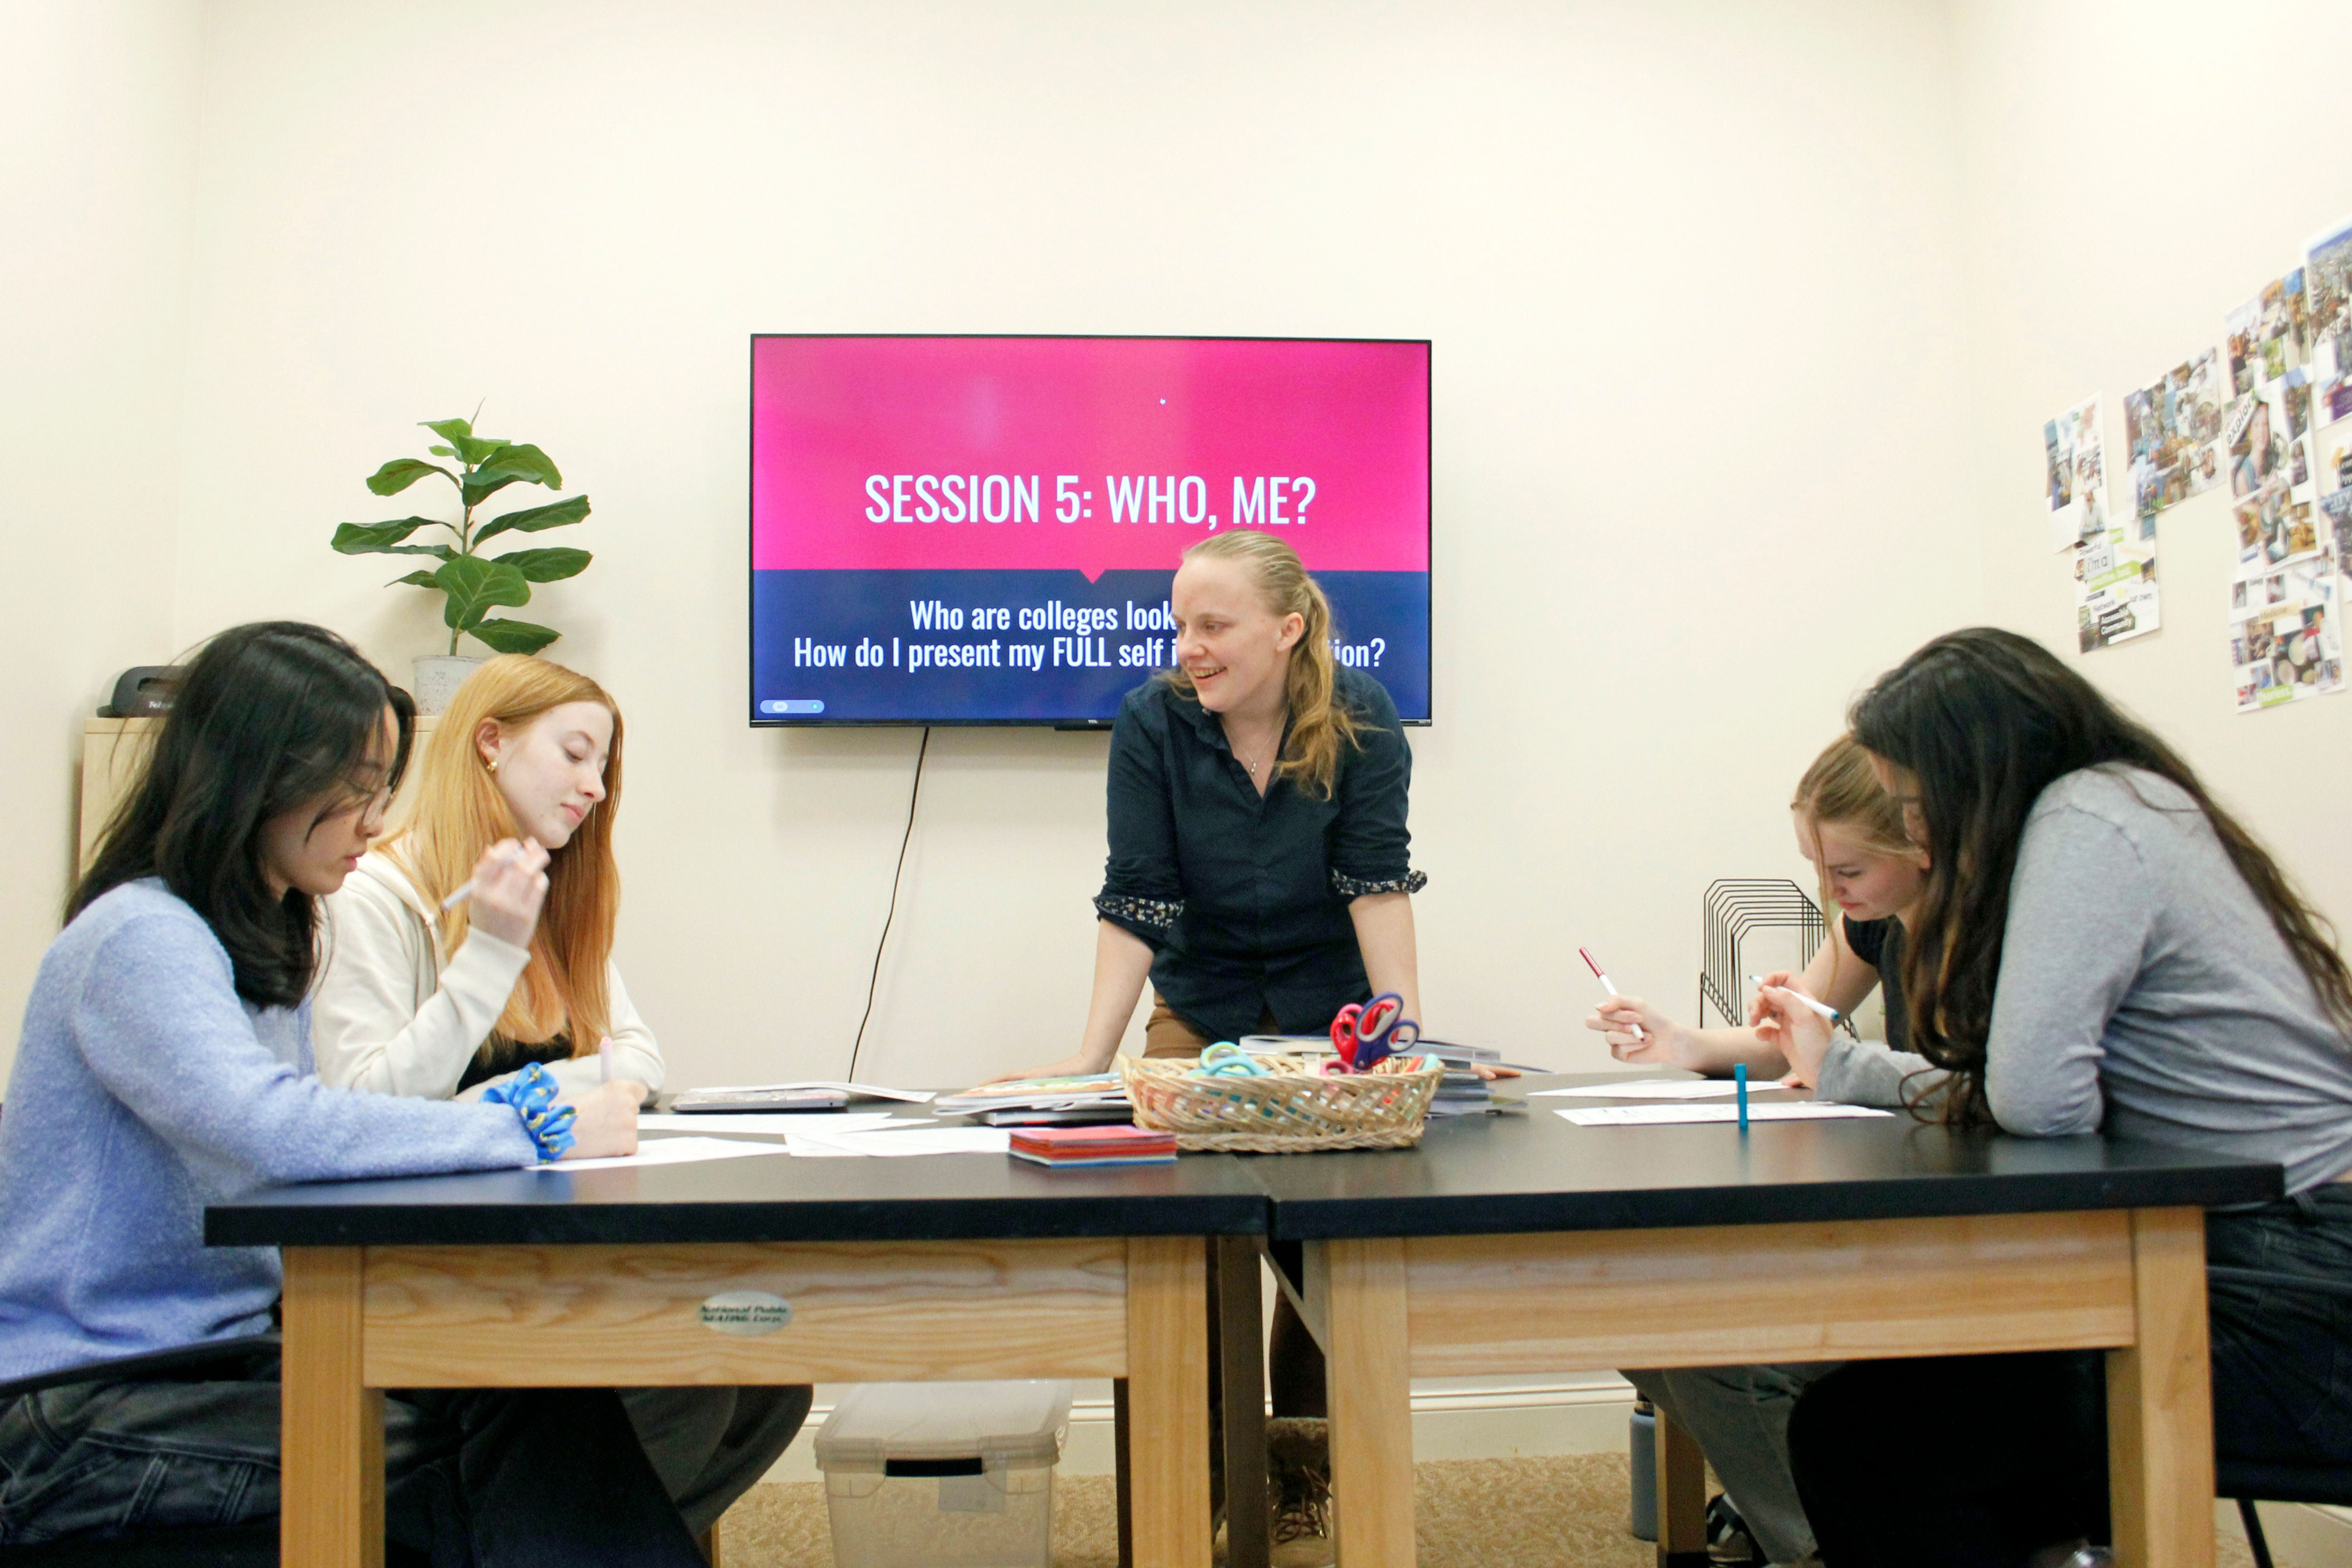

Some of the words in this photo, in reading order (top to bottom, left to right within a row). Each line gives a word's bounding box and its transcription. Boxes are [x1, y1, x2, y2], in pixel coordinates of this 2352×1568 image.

[865, 474, 1039, 523] SESSION
[1055, 475, 1092, 524] 5:
[1106, 475, 1217, 531] WHO,
[1232, 476, 1316, 525] ME?
[910, 600, 964, 630] Who
[971, 608, 1011, 630] are
[1018, 600, 1119, 636] colleges
[1126, 600, 1178, 631] look
[794, 637, 847, 667] How
[855, 637, 884, 667] do
[893, 637, 900, 667] I
[909, 639, 1001, 673] present
[1008, 644, 1046, 672] my
[1053, 636, 1112, 667] FULL
[1118, 636, 1164, 667] self
[1171, 638, 1178, 667] i
[1327, 637, 1386, 667] ion?
